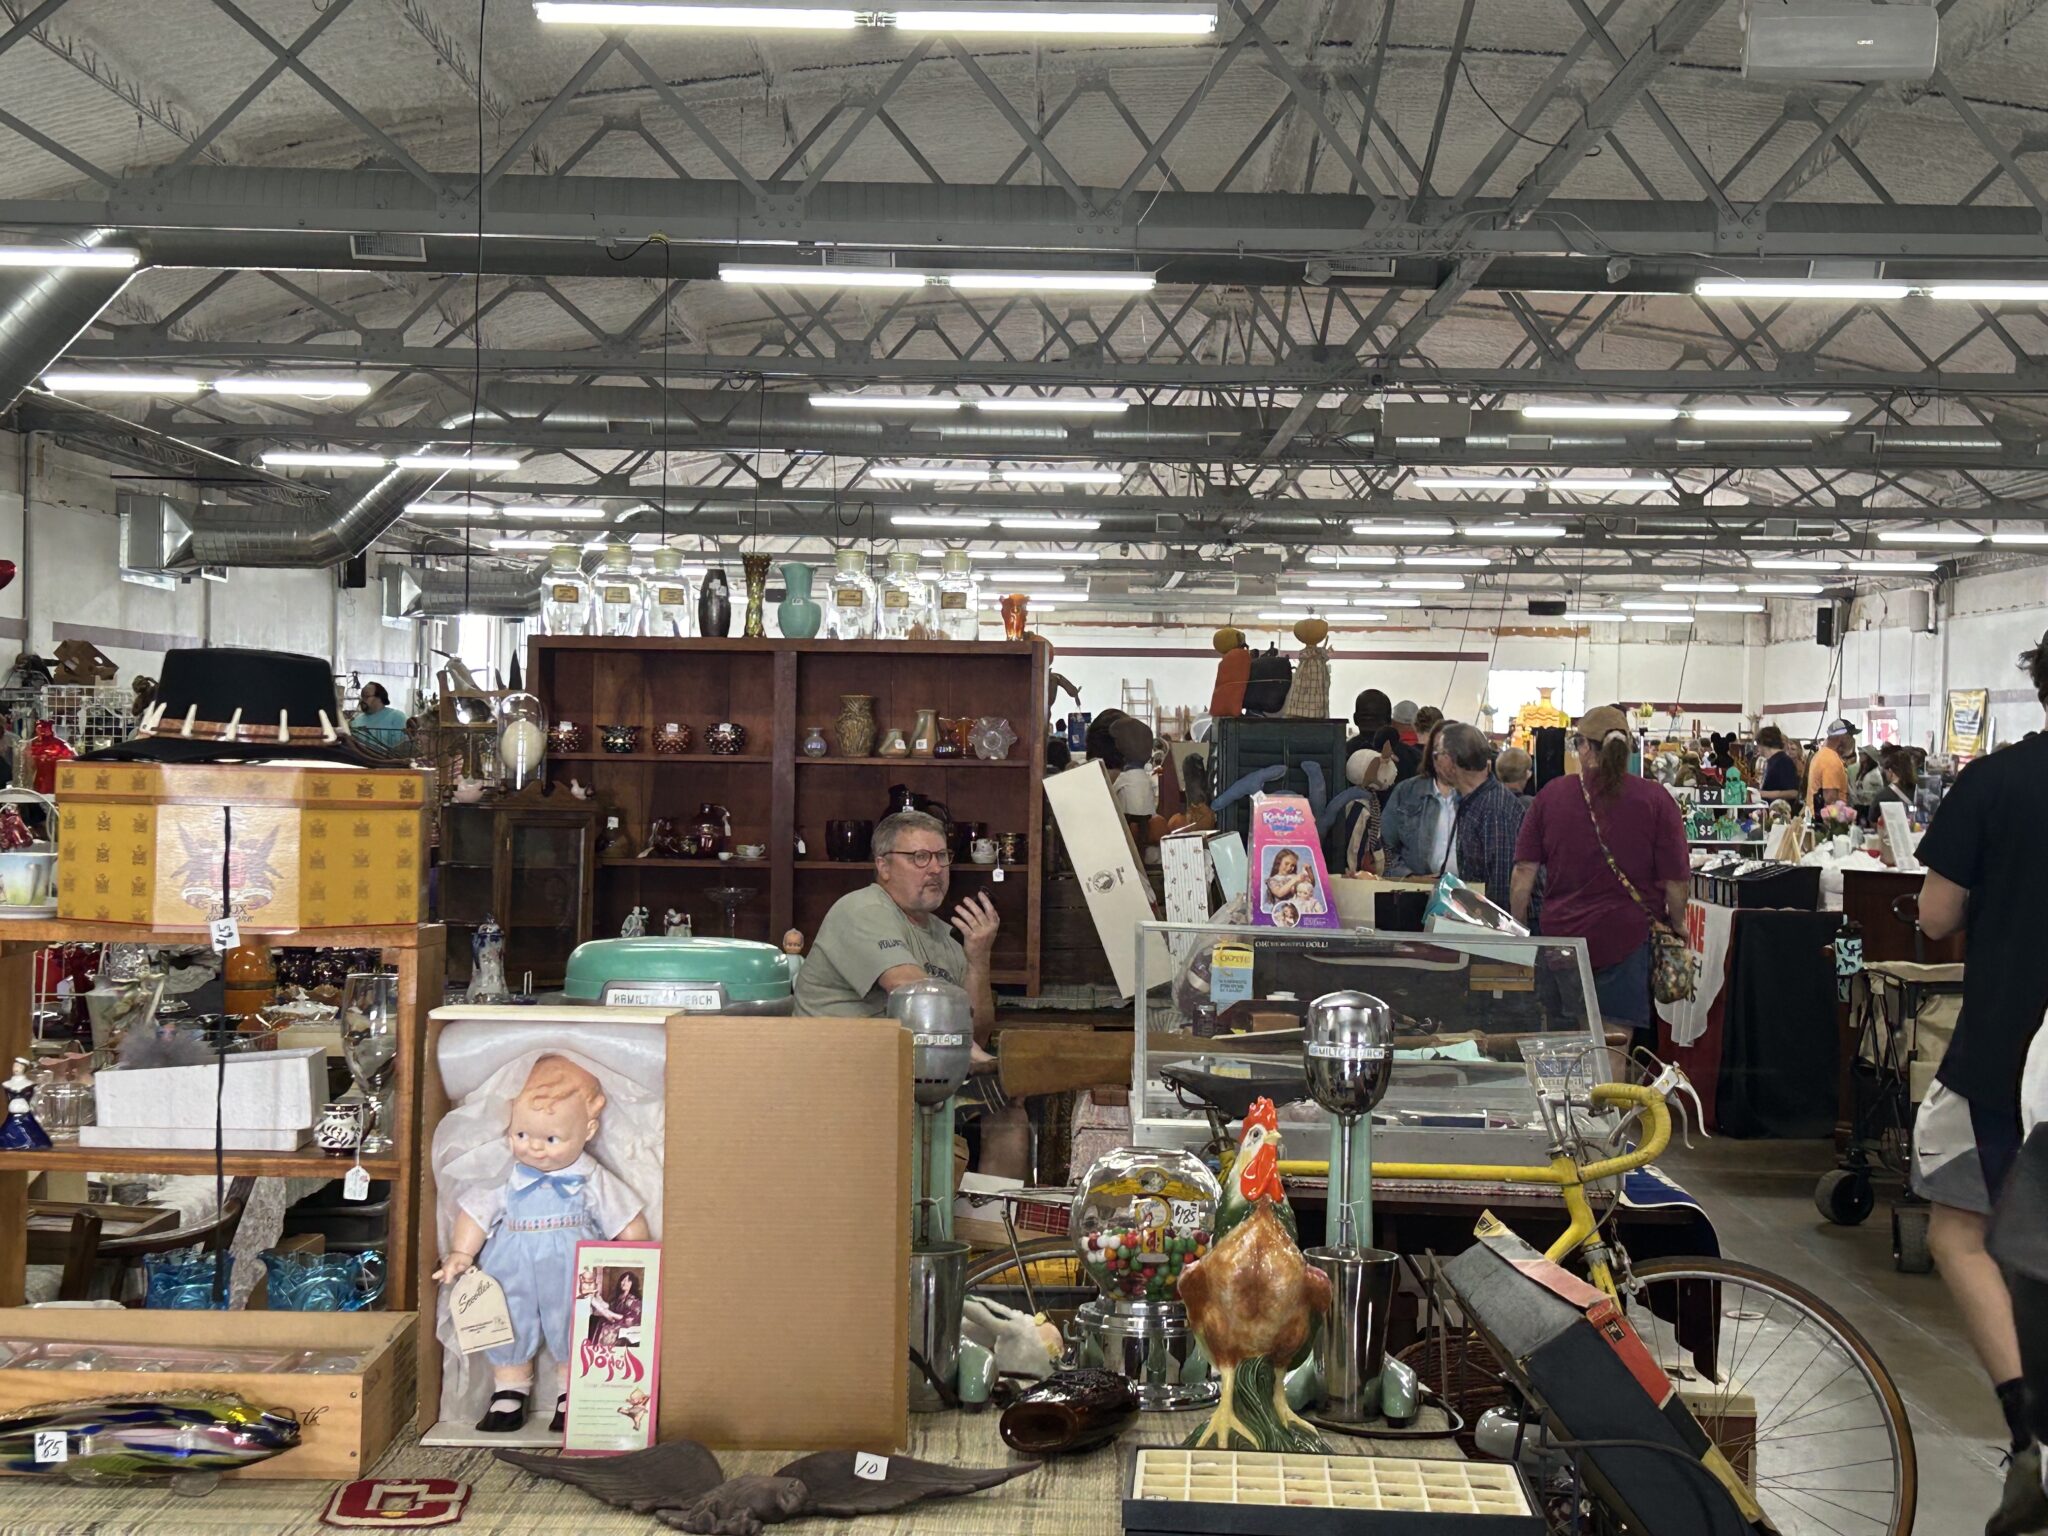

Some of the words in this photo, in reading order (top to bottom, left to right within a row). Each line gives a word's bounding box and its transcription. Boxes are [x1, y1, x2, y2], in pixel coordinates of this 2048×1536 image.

[1703, 790, 1718, 801] $7
[1699, 824, 1713, 836] $5
[209, 904, 247, 915] KOX
[856, 1460, 879, 1474] 10
